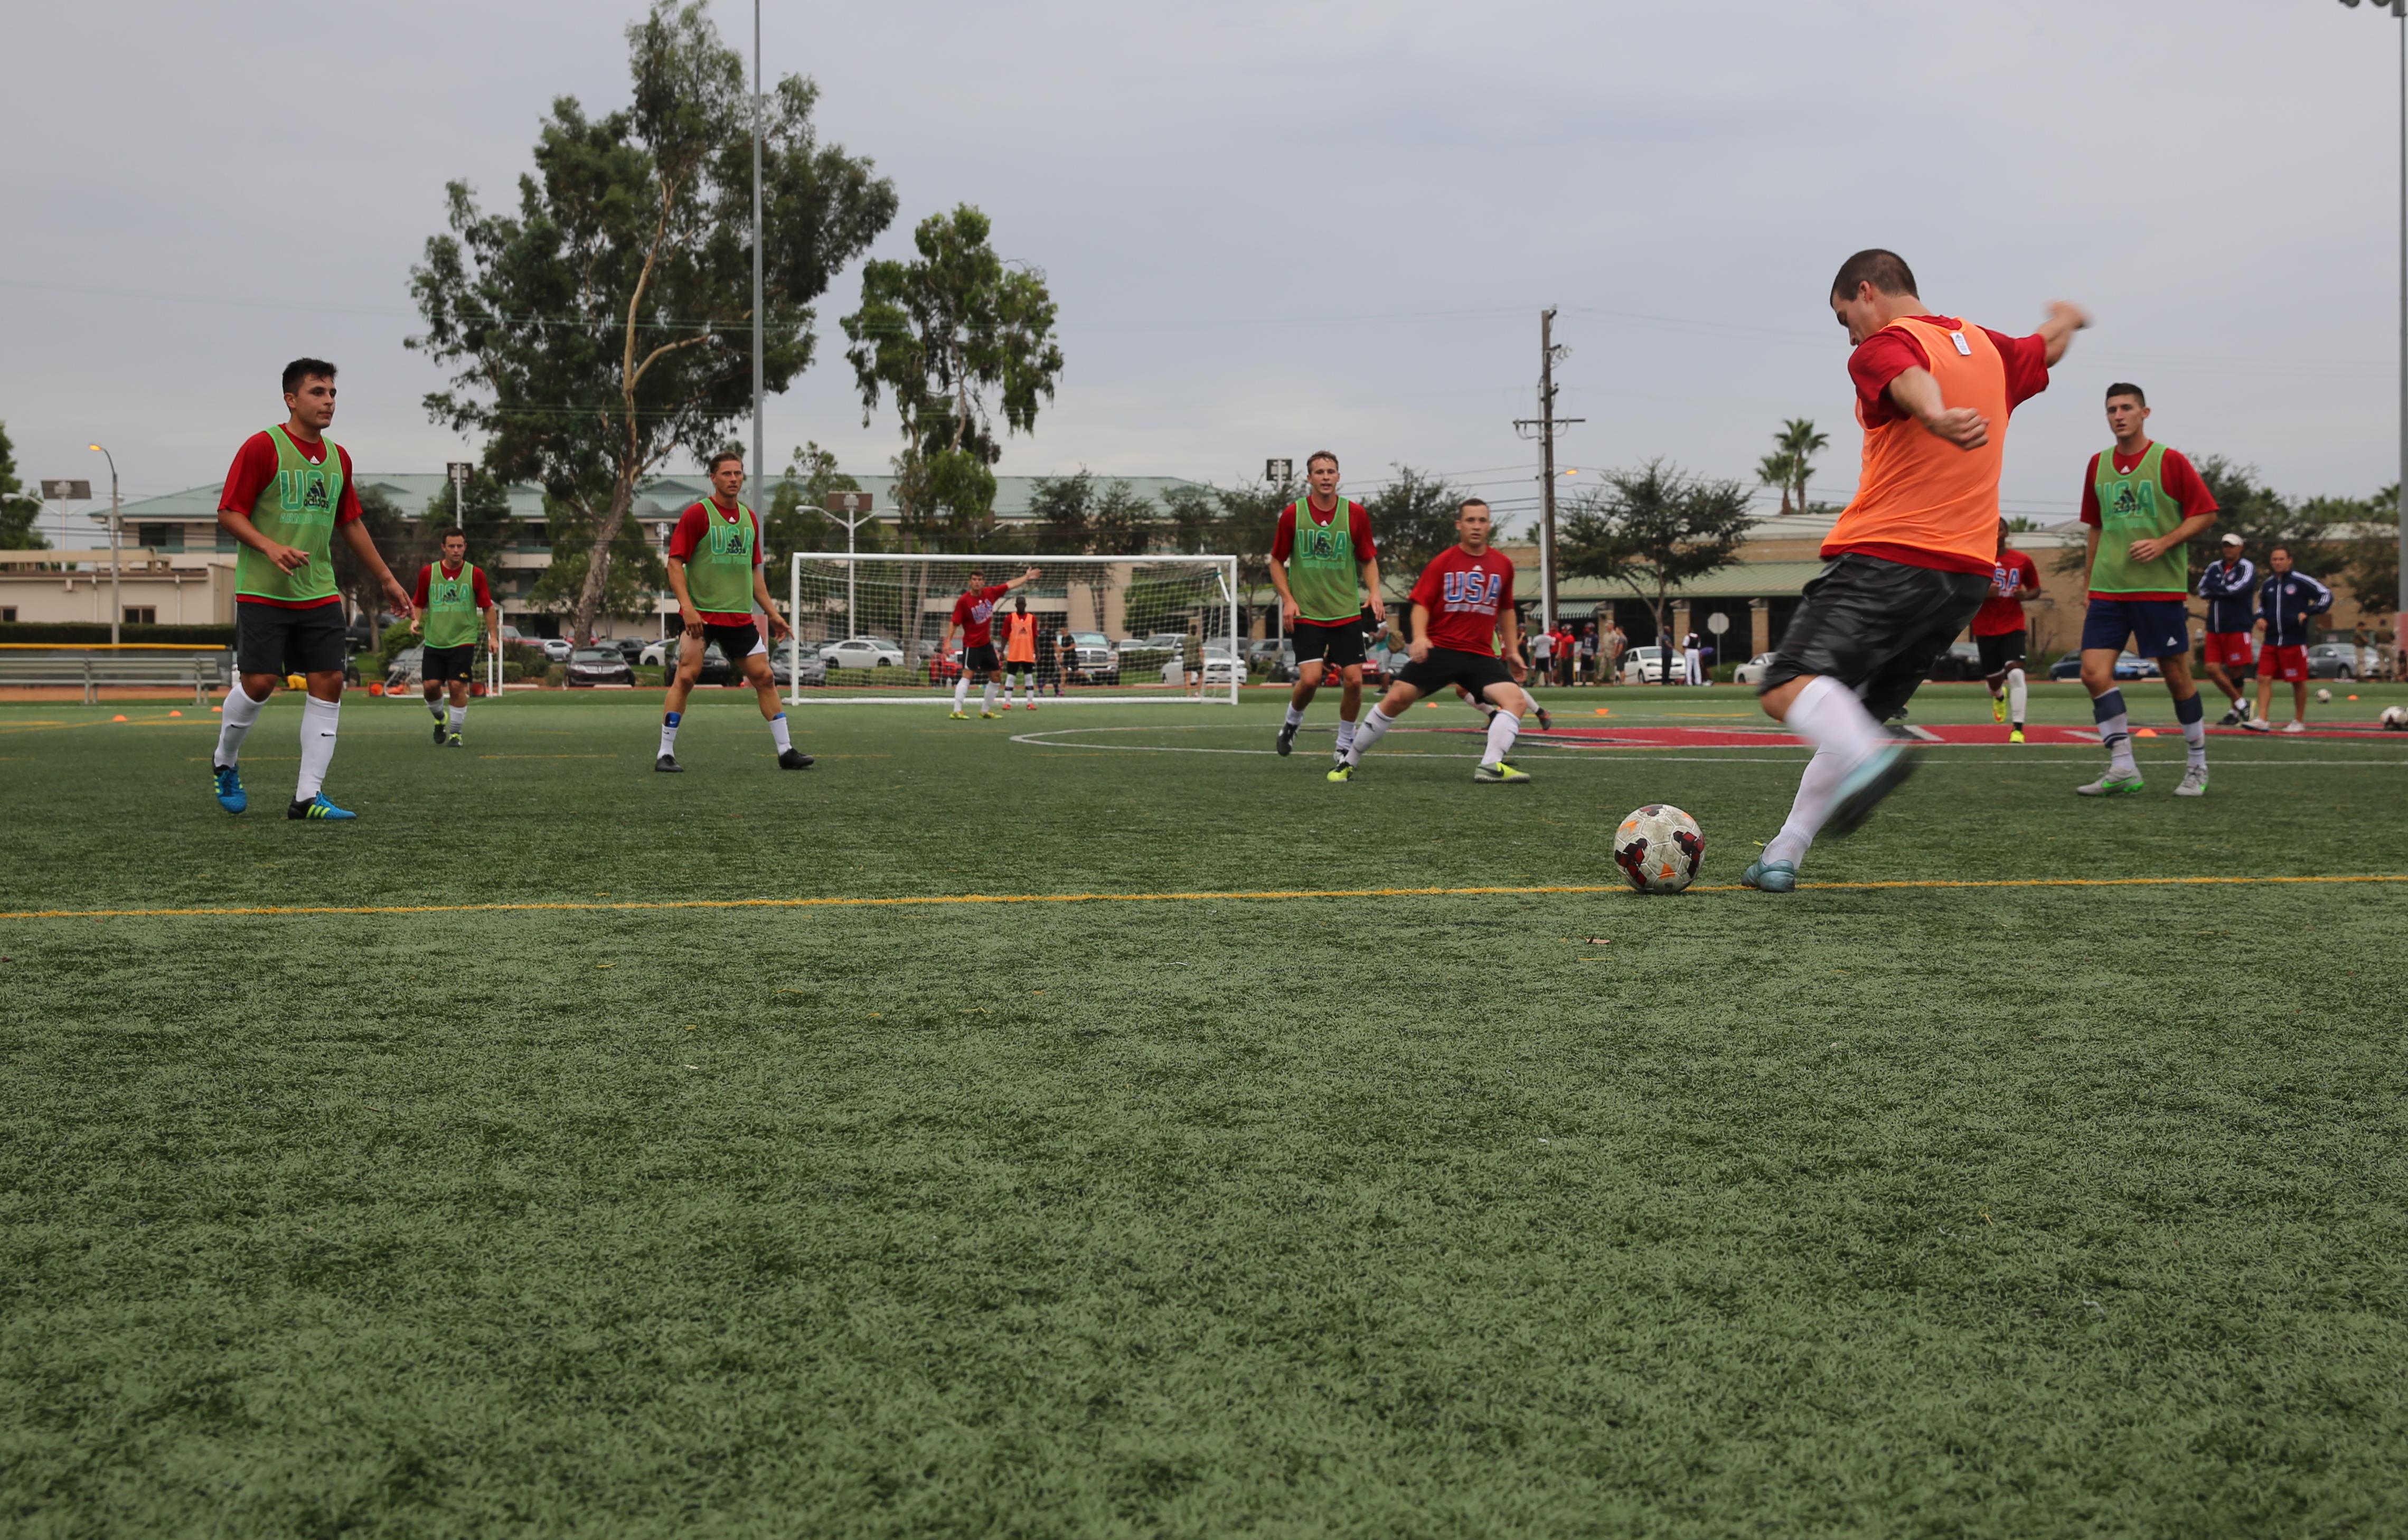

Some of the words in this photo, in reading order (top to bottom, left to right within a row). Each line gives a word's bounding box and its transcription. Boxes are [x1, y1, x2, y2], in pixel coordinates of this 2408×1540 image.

[1297, 529, 1347, 560] USA
[1443, 571, 1501, 606] USA
[1993, 568, 2019, 591] SA
[431, 583, 469, 605] USA
